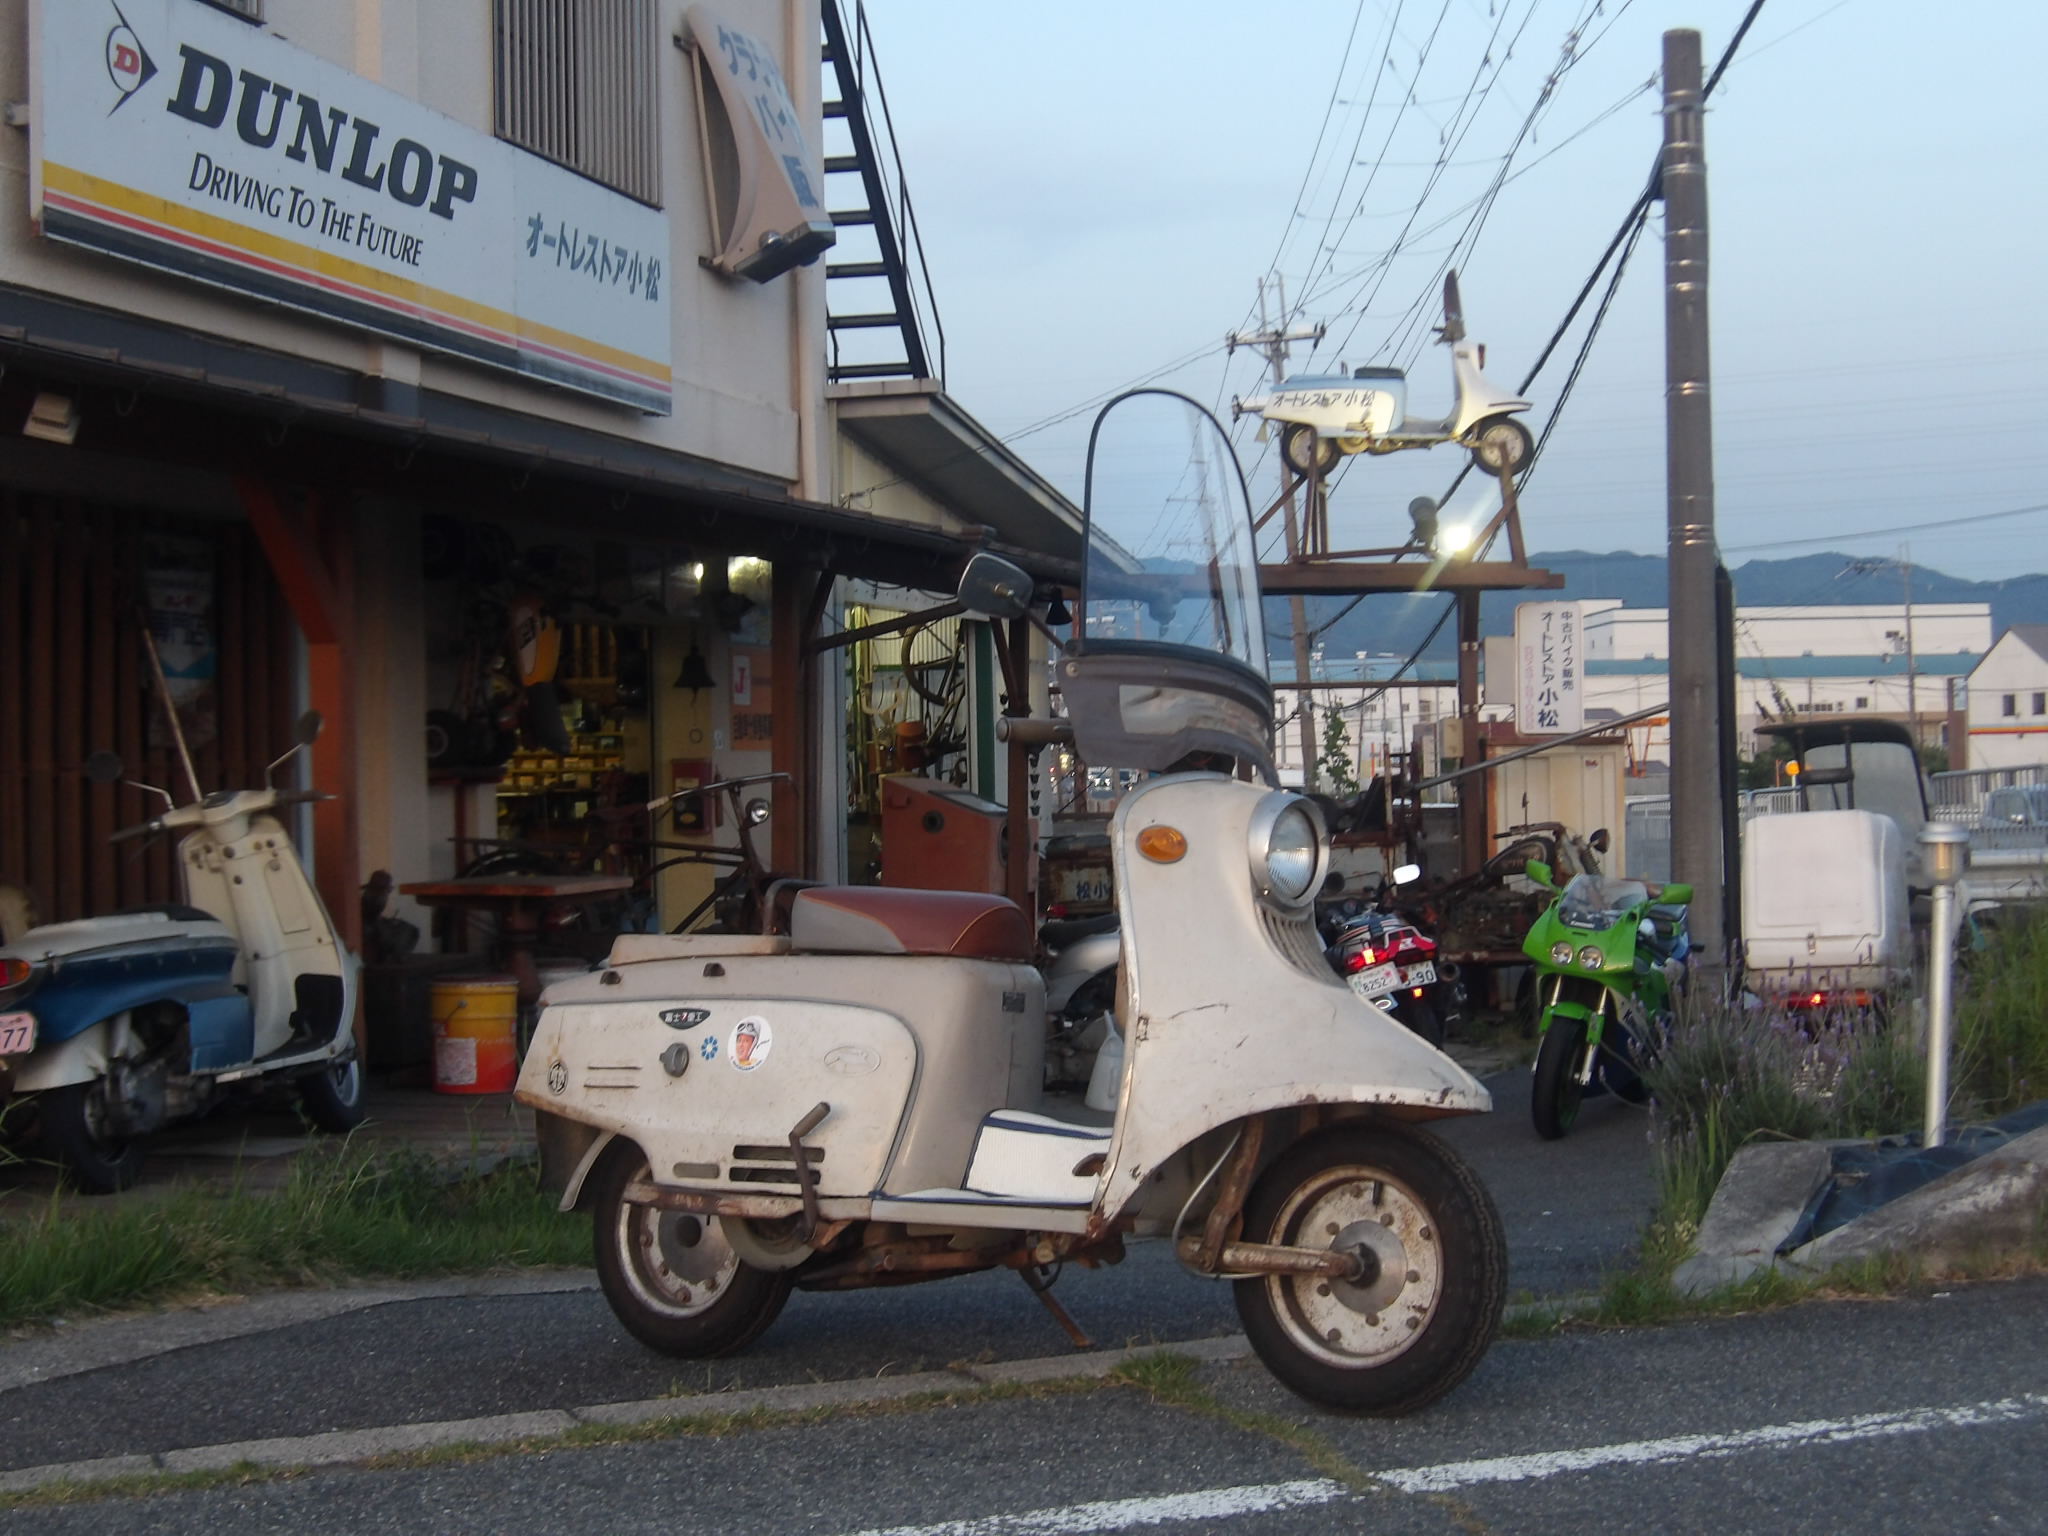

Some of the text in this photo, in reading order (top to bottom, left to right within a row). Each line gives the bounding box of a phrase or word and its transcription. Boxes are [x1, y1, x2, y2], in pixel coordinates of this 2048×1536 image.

[113, 43, 140, 75] D
[166, 42, 478, 221] DUNLOP
[188, 152, 424, 267] DRIVING TO THE FUTURE
[526, 212, 661, 302] オートレストア小松
[1538, 610, 1559, 728] オートレストア小松
[1561, 610, 1575, 691] 中古バイク販売
